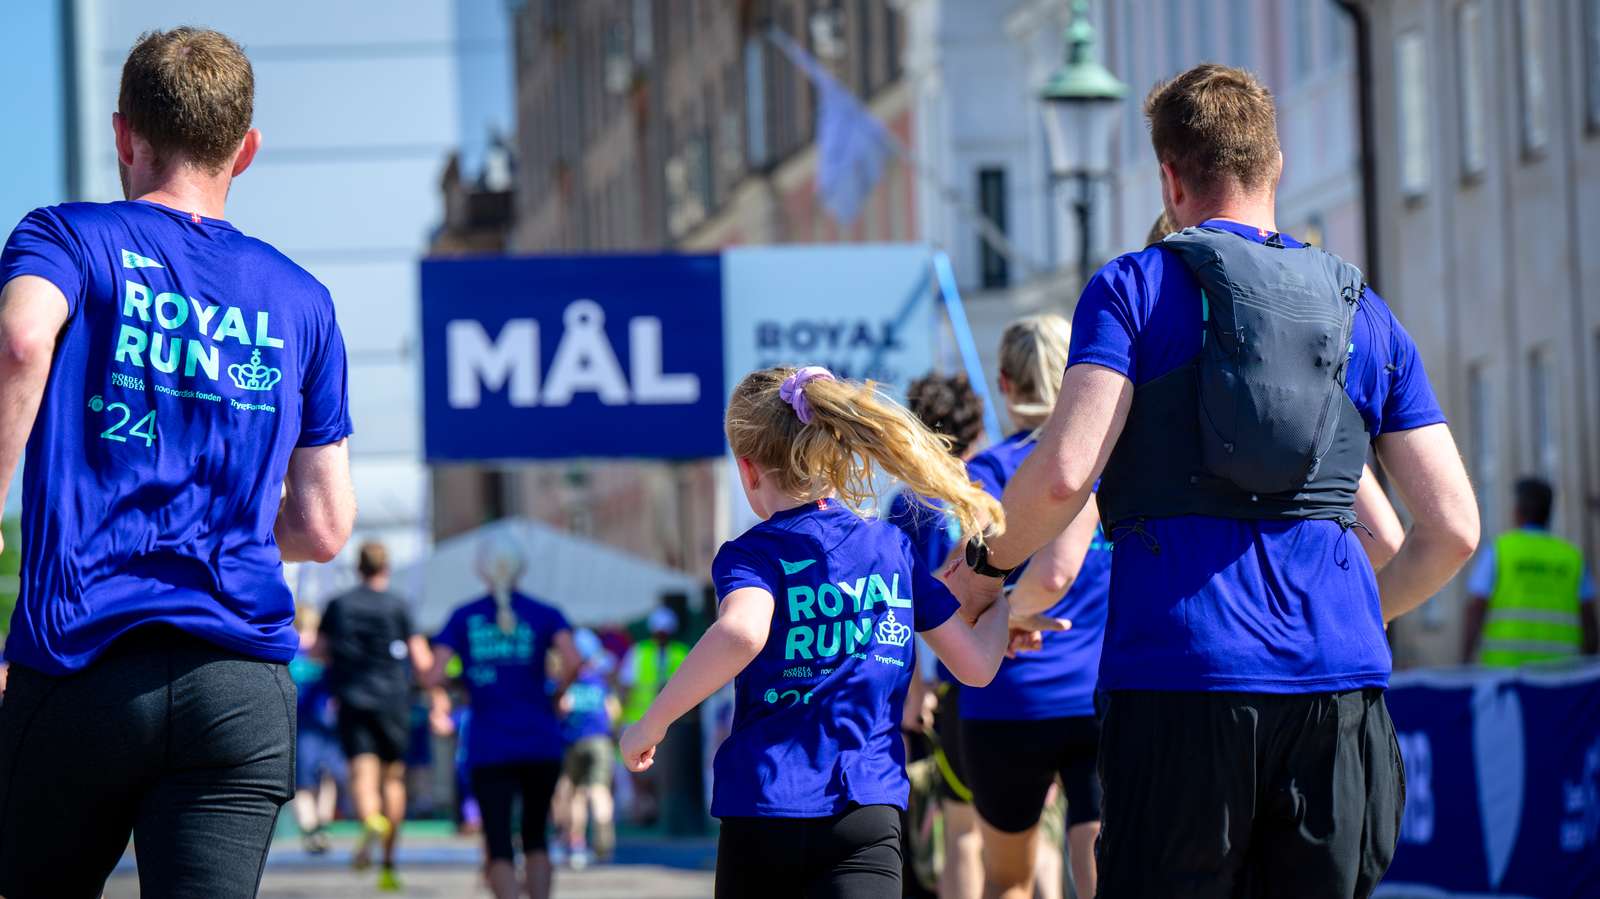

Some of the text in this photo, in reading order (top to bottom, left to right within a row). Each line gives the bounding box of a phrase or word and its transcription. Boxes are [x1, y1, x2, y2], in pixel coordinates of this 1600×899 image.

[123, 279, 284, 349] ROYAL
[756, 320, 903, 351] ROYAL
[114, 324, 220, 381] RUN
[446, 298, 701, 409] MÅL
[112, 372, 144, 385] NORDEA
[112, 378, 145, 391] FONDEN
[154, 384, 221, 402] novo nordisk fonden
[100, 401, 157, 448] 24
[787, 573, 912, 622] ROYAL
[785, 616, 873, 660] RUN
